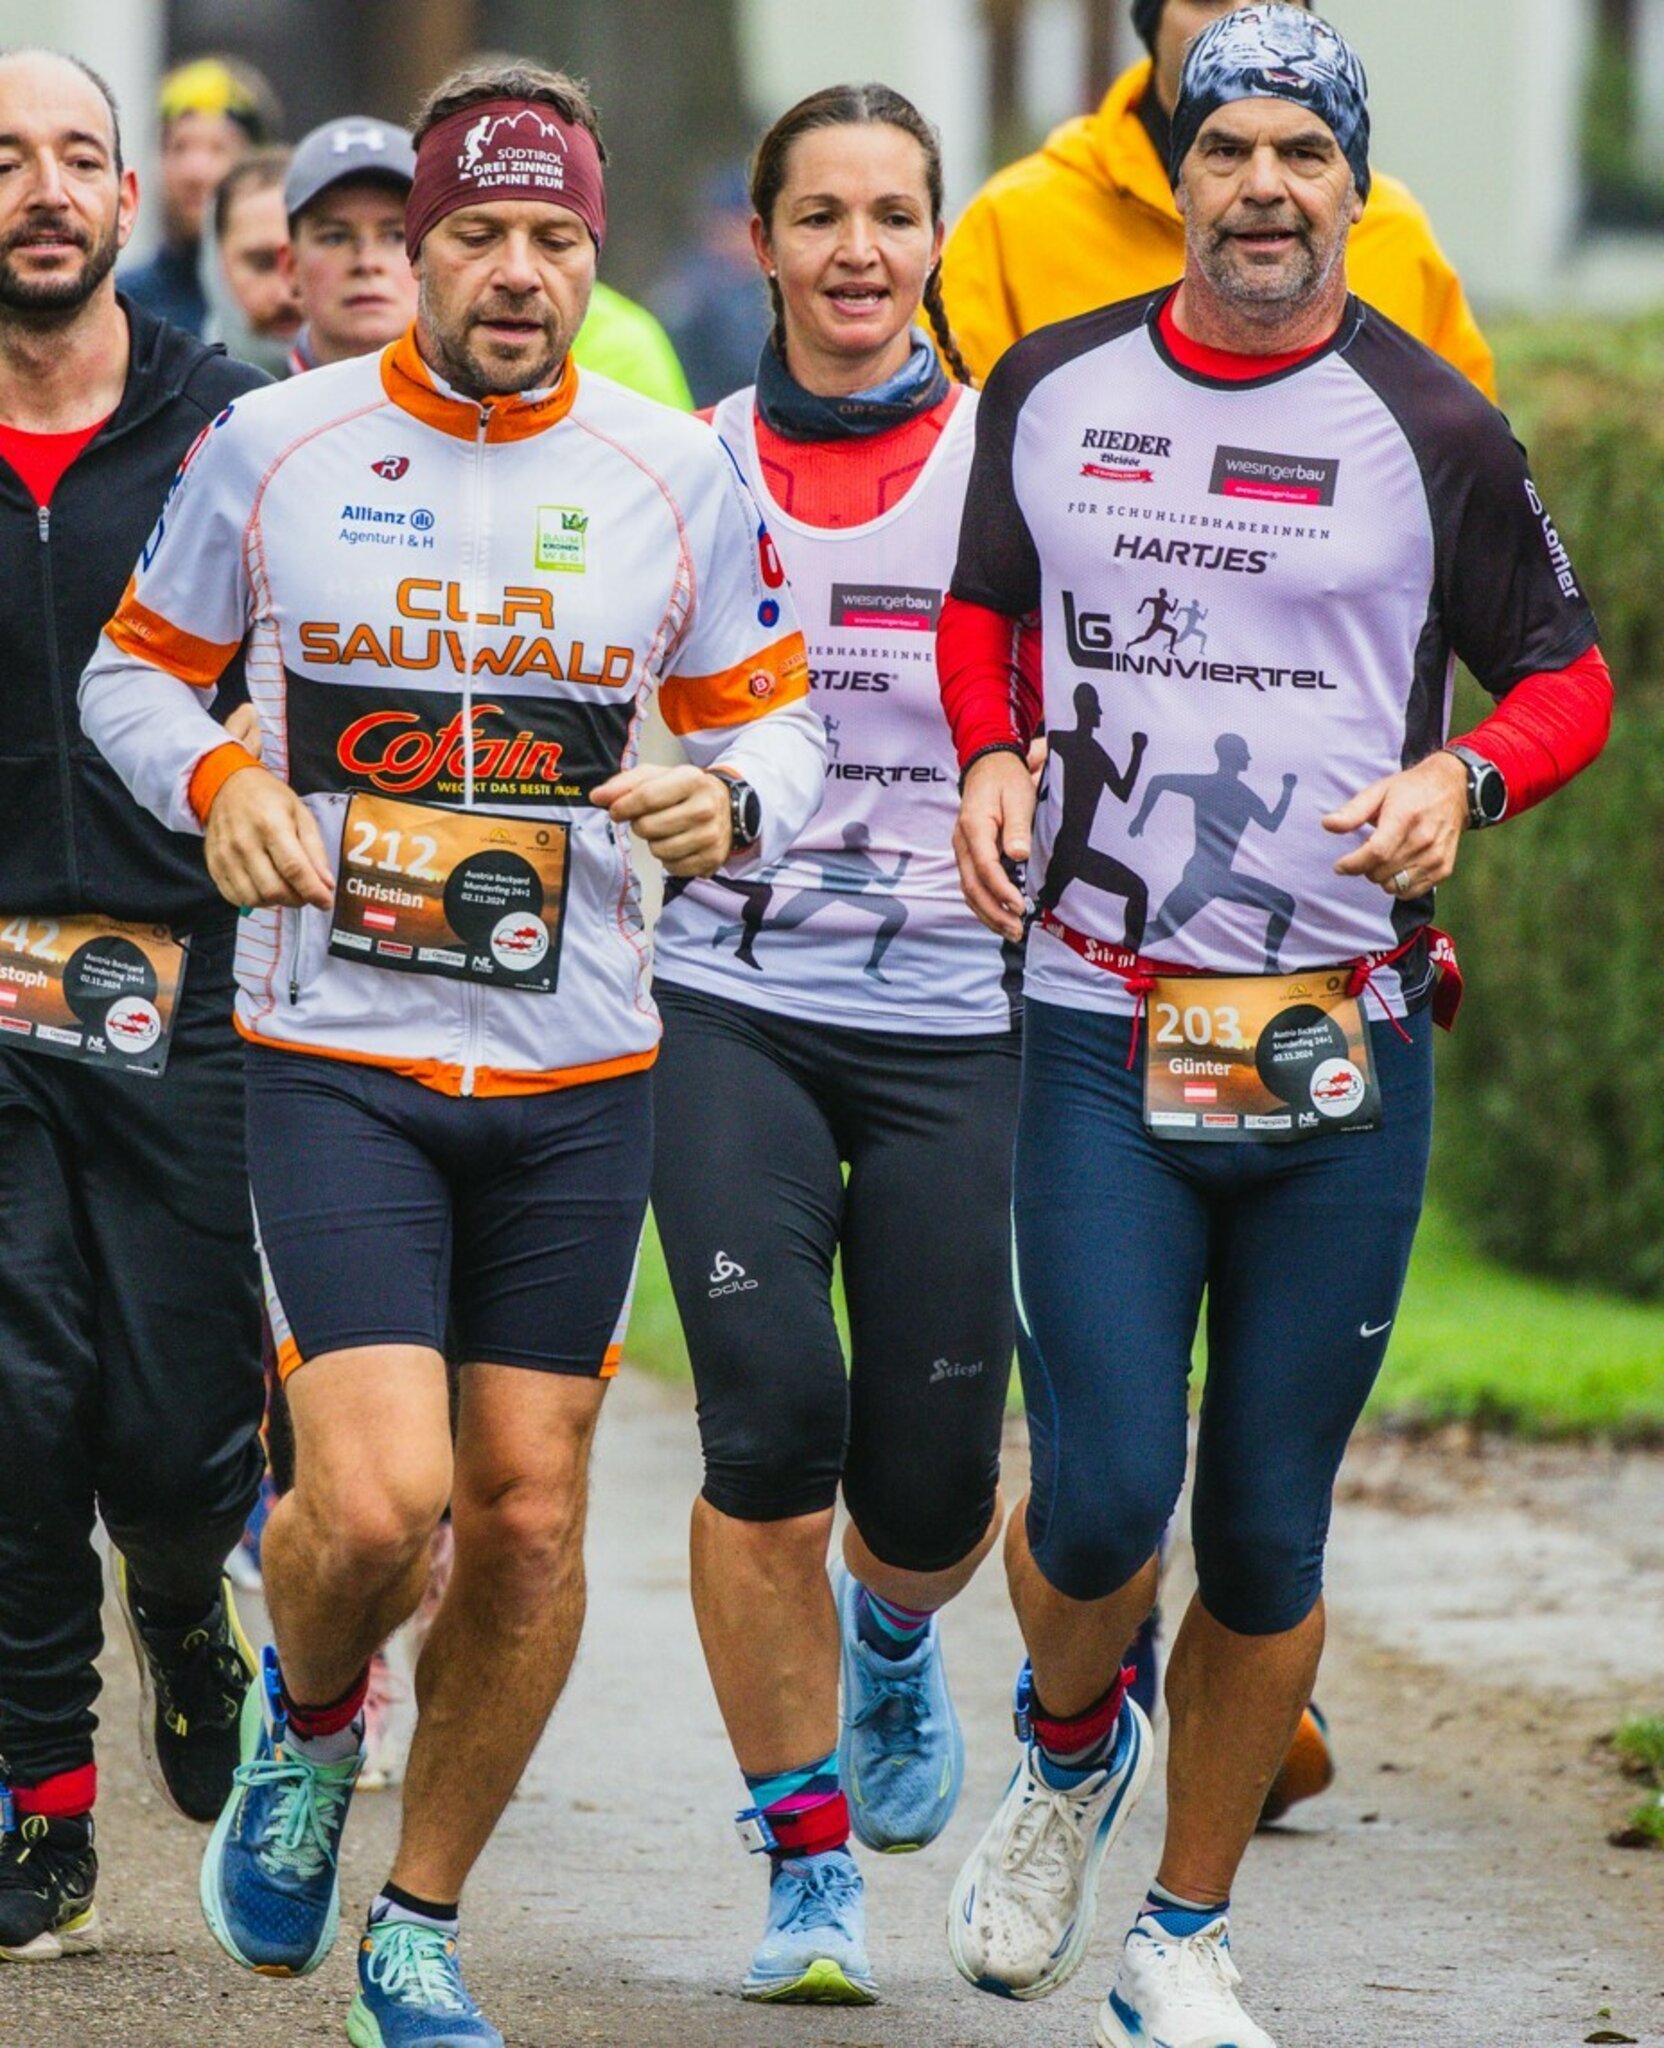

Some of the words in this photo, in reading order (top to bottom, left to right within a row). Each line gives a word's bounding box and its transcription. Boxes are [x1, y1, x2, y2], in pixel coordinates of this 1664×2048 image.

[497, 147, 564, 165] SÜDTIROL
[473, 161, 507, 177] DREI
[511, 161, 564, 177] ZINNEN
[477, 173, 530, 188] ALPINE
[534, 174, 564, 190] RUN
[1081, 428, 1172, 458] RIEDER
[1225, 458, 1326, 483] wiesingerbau
[341, 505, 406, 526] Allianz
[1068, 501, 1098, 514] FÜR
[1106, 505, 1332, 540] SCHUHLIEBHABERINNEN
[338, 528, 397, 546] Agentur
[407, 533, 418, 547] &
[422, 535, 434, 549] H
[396, 577, 555, 630] CLR
[842, 592, 932, 610] wiesingerbau
[299, 621, 634, 688] SAUWALD
[336, 704, 564, 793] Cofain
[490, 783, 516, 794] DAS
[520, 784, 551, 795] BESTE
[347, 820, 438, 880] 212
[346, 877, 424, 909] Christian
[0, 964, 48, 988] stoph
[1156, 1003, 1242, 1048] 203
[1169, 1058, 1231, 1076] Günter
[708, 1279, 758, 1299] odlo
